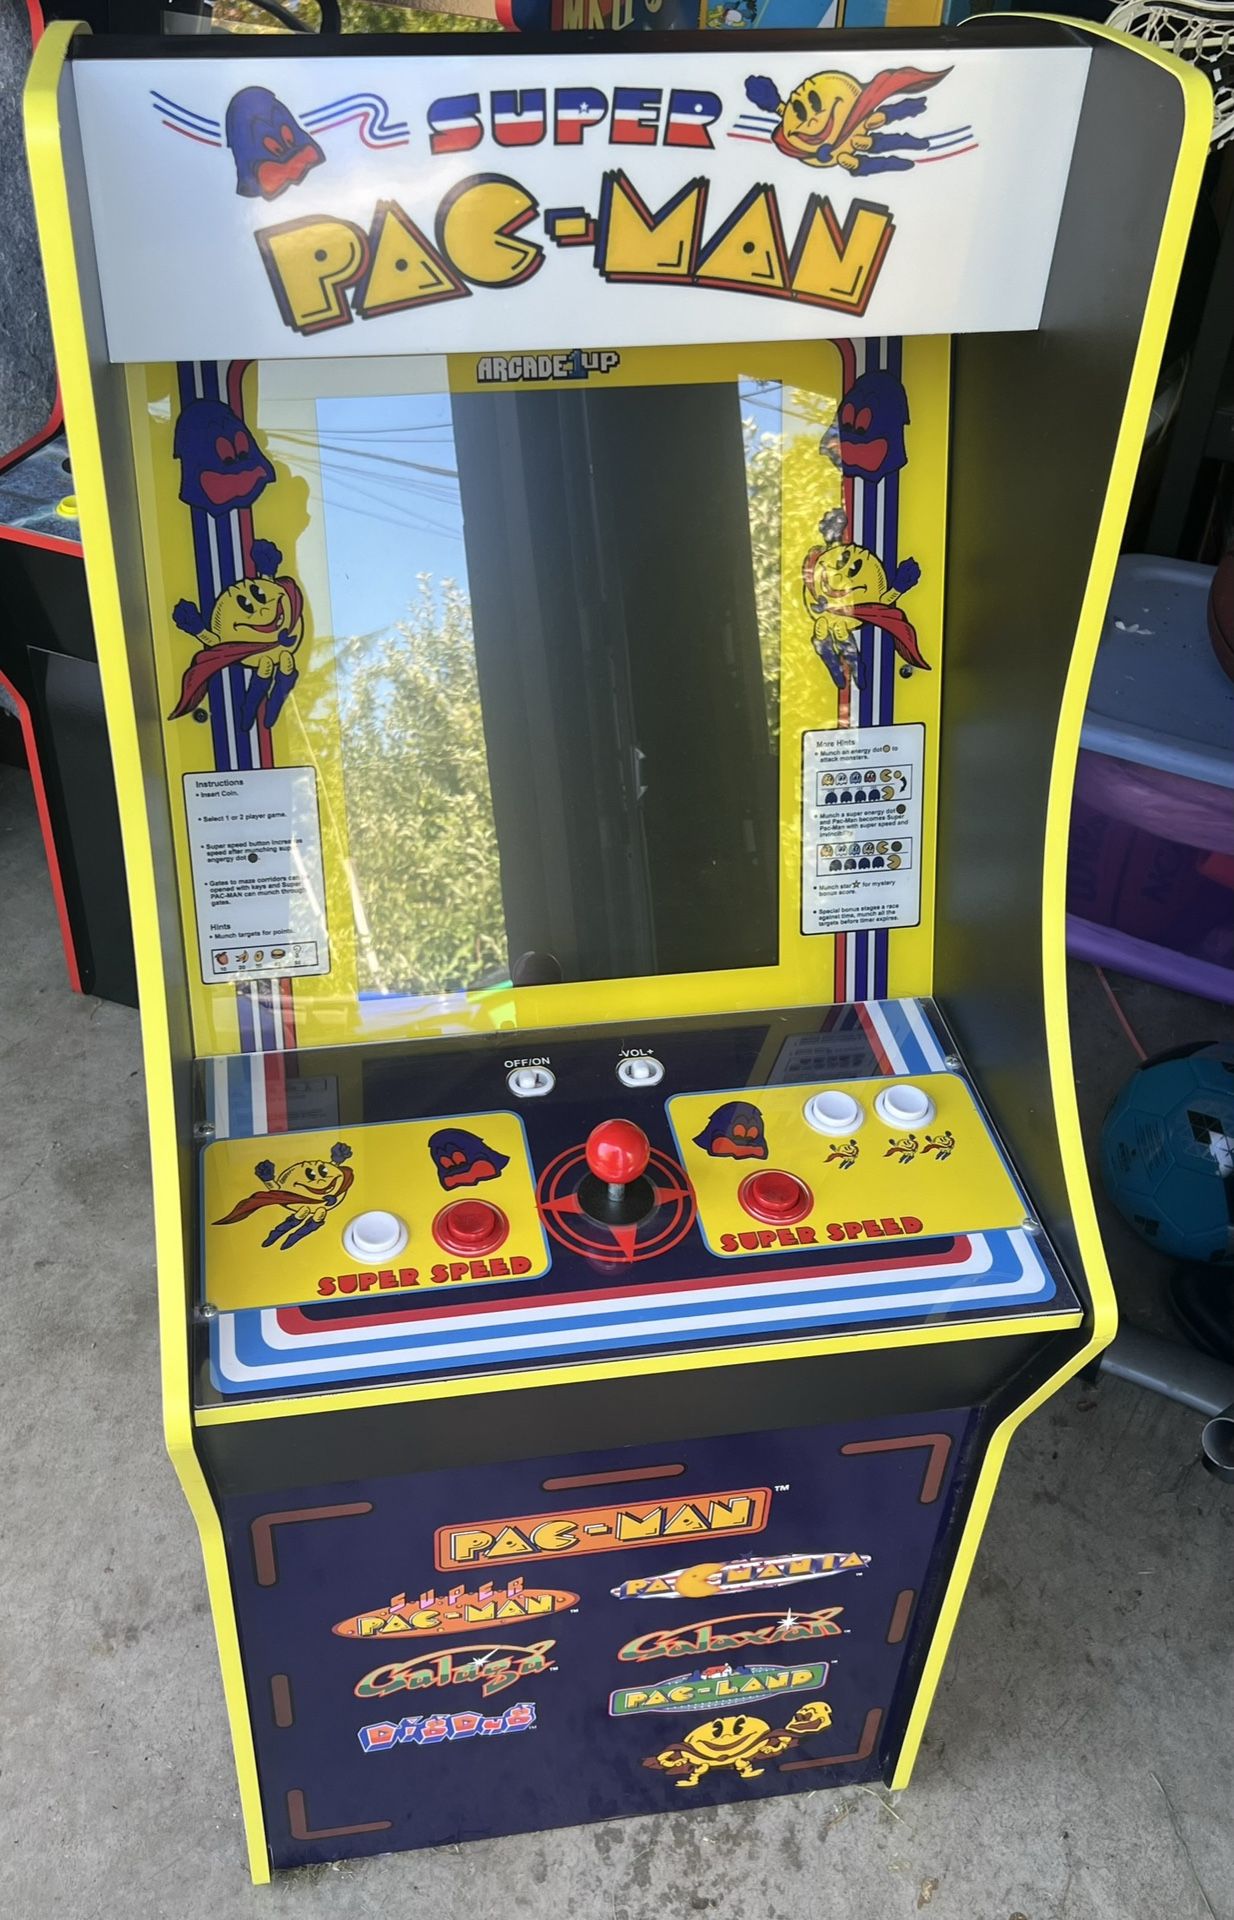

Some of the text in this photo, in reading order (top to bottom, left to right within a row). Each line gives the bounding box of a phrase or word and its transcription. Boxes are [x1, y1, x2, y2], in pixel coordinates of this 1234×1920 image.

[427, 87, 723, 155] SUPER
[254, 167, 896, 336] PAC-MAN
[477, 348, 620, 383] ARCADE1UP
[836, 739, 855, 747] Hints
[840, 754, 870, 762] monsters.
[196, 779, 244, 788] Instructions
[245, 813, 265, 822] player
[267, 811, 288, 820] game.
[878, 820, 896, 828] speed
[227, 841, 247, 849] speed
[206, 850, 227, 858] speed
[245, 846, 278, 854] munching
[257, 876, 287, 884] corridors
[872, 879, 896, 888] mystery
[252, 883, 266, 891] keys
[839, 888, 856, 896] score.
[861, 904, 880, 912] stages
[819, 919, 839, 927] targets
[840, 917, 859, 925] before
[876, 915, 898, 924] expires.
[504, 1056, 551, 1069] OFF/ON
[720, 1216, 924, 1253] SUPER SPEED
[317, 1256, 532, 1296] SUPER SPEED
[450, 1496, 756, 1563] PAC-MAN
[390, 1576, 524, 1614] SUPER
[357, 1594, 556, 1637] PAC-MAN
[617, 1607, 845, 1663] Galaxian
[354, 1639, 556, 1698] Galaga
[624, 1670, 814, 1709] PAC-LAND
